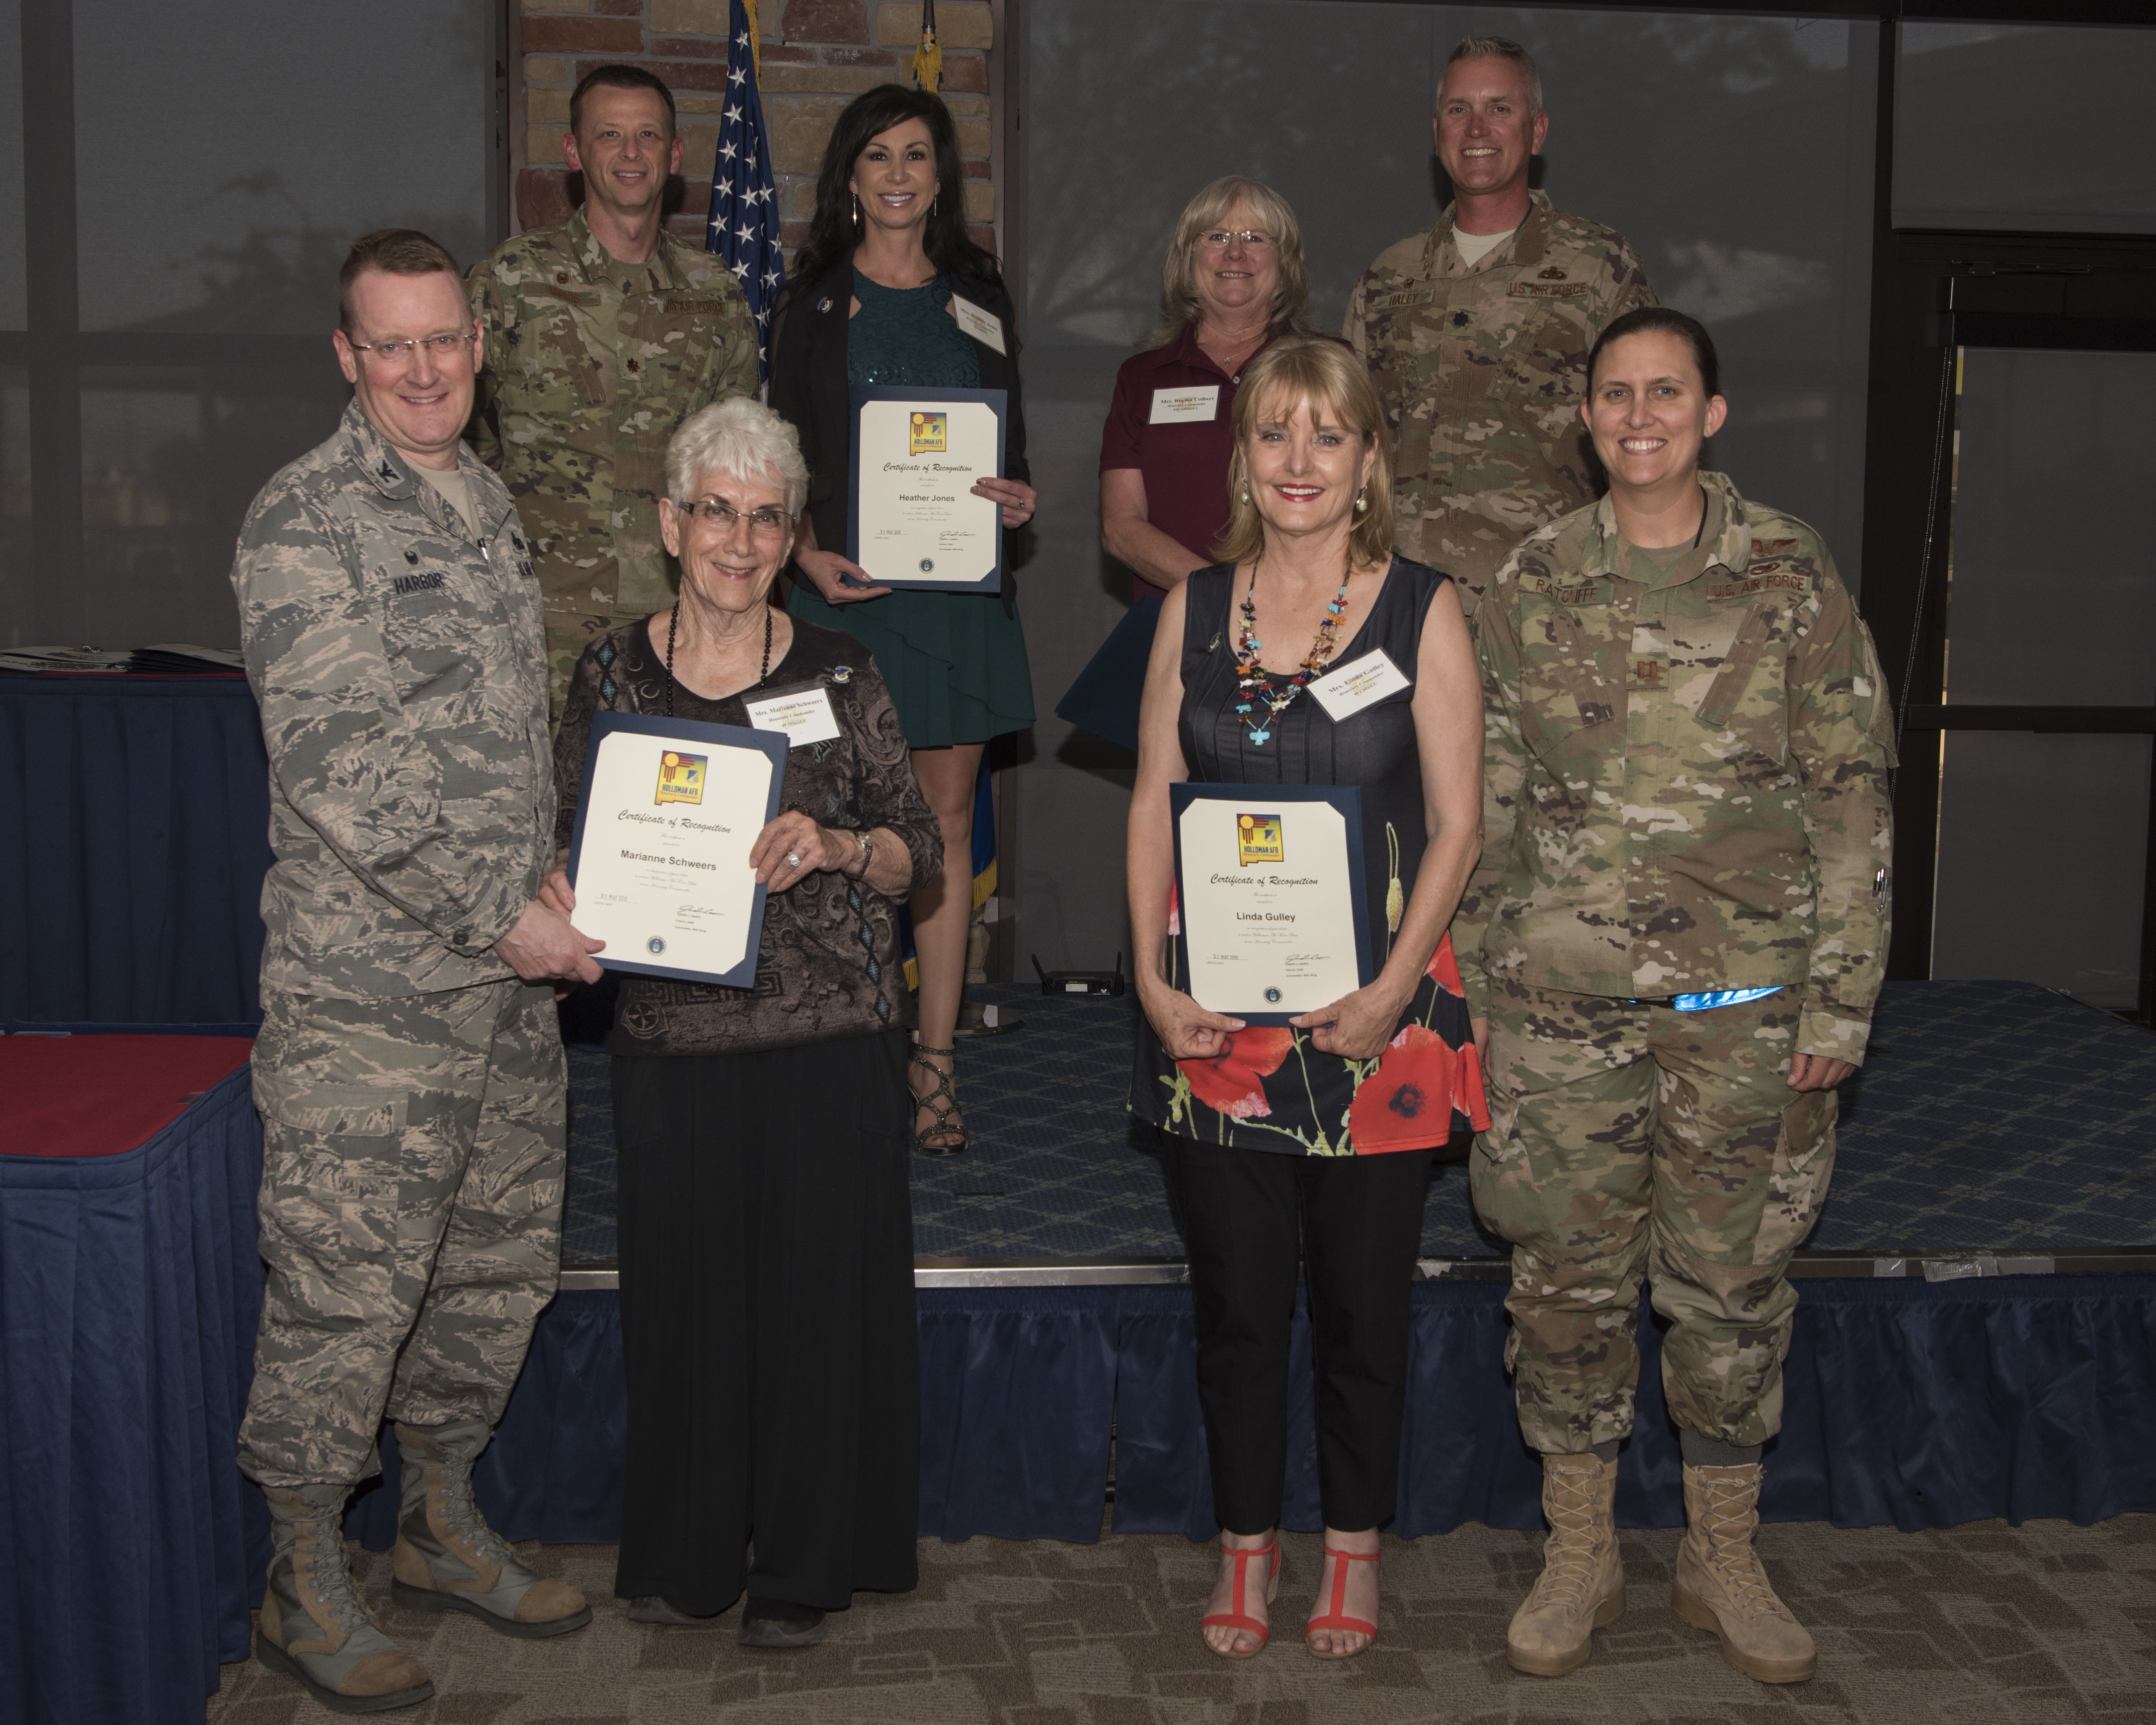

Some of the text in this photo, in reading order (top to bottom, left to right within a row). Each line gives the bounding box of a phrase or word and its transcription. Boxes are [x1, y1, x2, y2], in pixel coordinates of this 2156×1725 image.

[1509, 282, 1587, 296] U.S. AIR FORCE
[680, 301, 694, 312] AIR
[696, 301, 724, 314] FORCE
[1389, 293, 1418, 307] HALEY
[883, 462, 972, 474] Certificate of Recognition
[394, 573, 445, 594] HARBOR
[1535, 578, 1597, 604] RATCLIFFE
[1714, 575, 1805, 597] U.S. AIR FORCE
[1345, 673, 1363, 685] Linda
[1364, 662, 1384, 675] Gulley
[769, 705, 797, 714] Marianne
[797, 699, 823, 708] Schweers
[790, 709, 815, 718] Commander
[662, 784, 688, 794] HOLLOMAN
[618, 809, 731, 833] Certificate of Recognition
[621, 850, 717, 871] Marianne Schweers
[1210, 873, 1318, 888] Certificate of Recognition
[1266, 913, 1295, 922] Gulley
